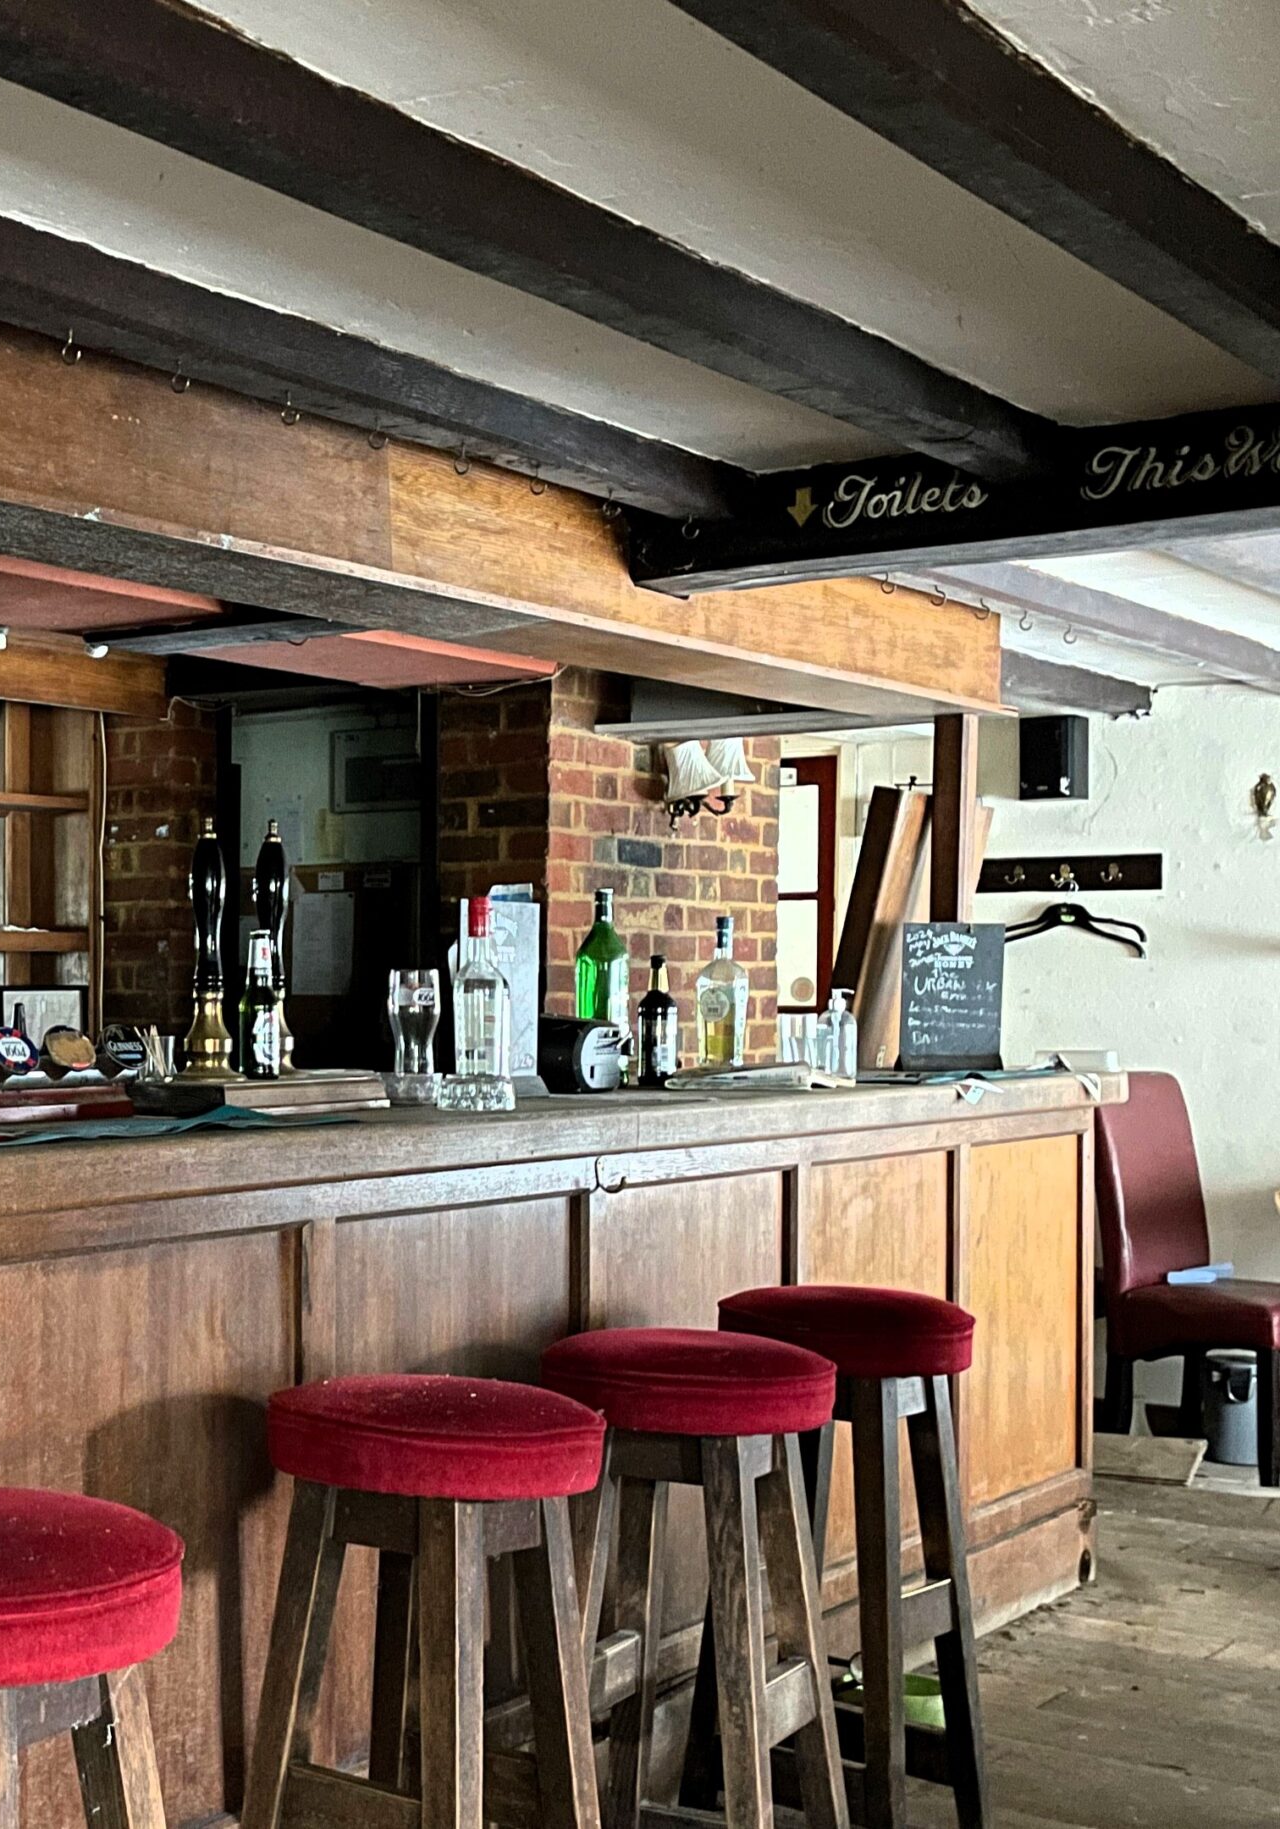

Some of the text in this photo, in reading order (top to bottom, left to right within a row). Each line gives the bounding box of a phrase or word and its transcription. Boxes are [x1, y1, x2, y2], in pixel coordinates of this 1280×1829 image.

[823, 470, 987, 528] Toilets
[1082, 445, 1220, 501] This
[4, 1044, 27, 1057] 1664
[107, 1040, 144, 1052] GUINNESS
